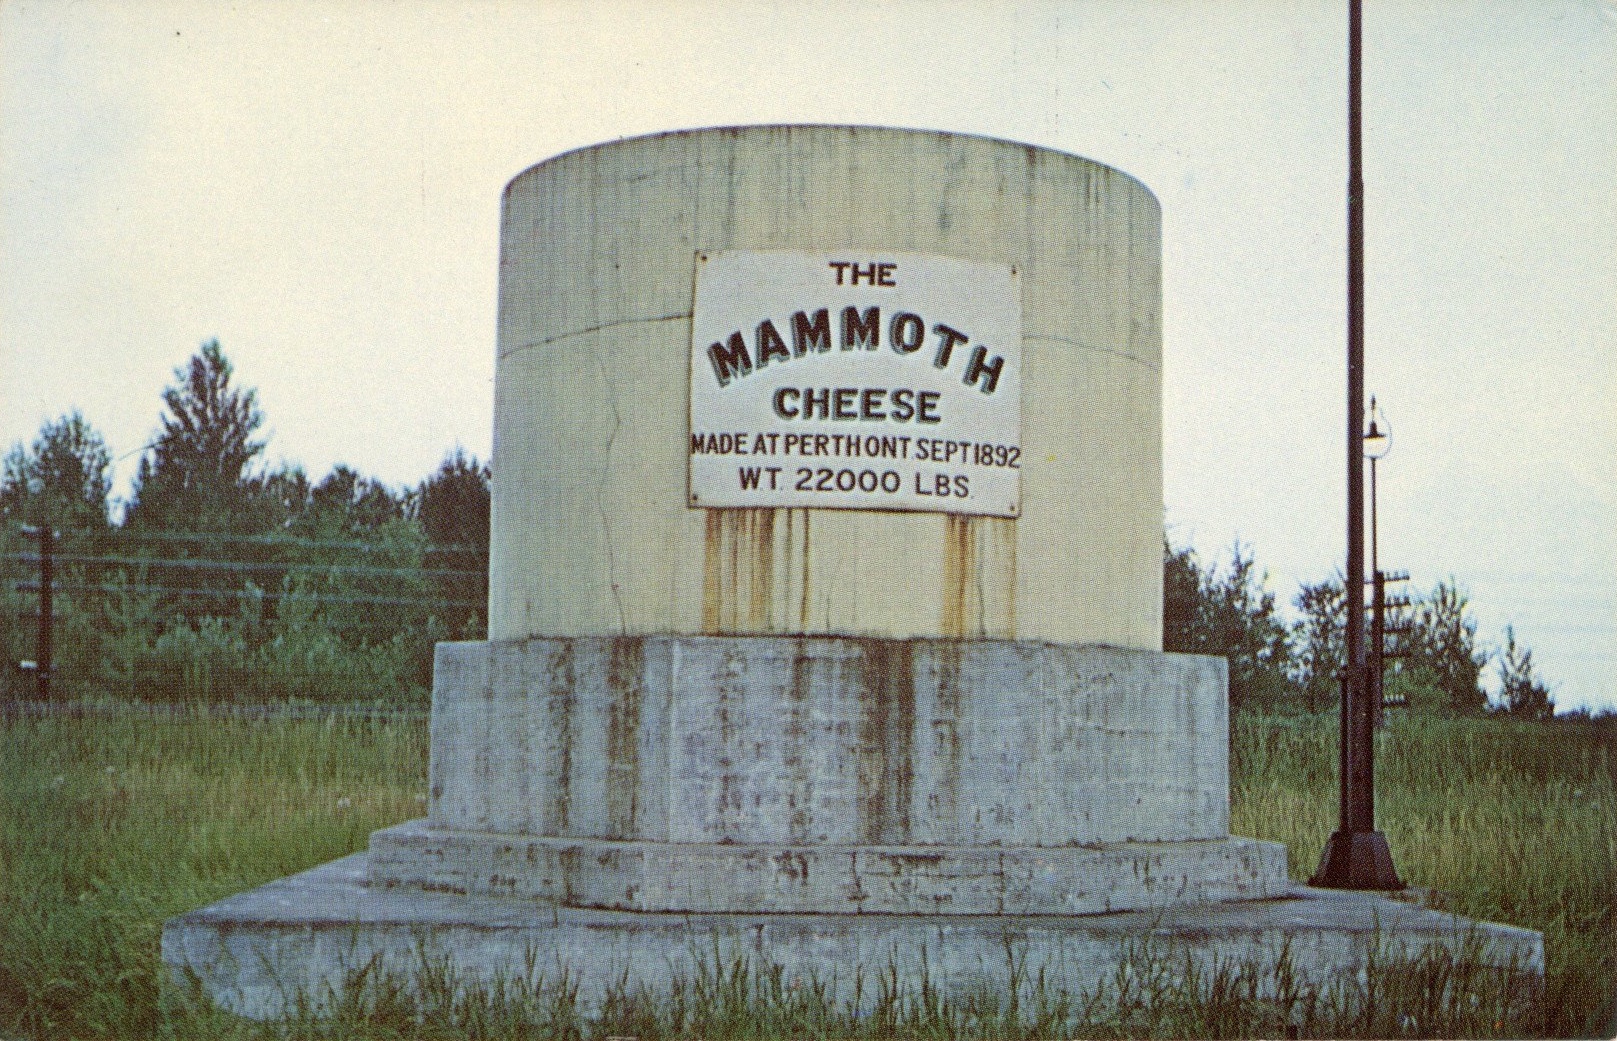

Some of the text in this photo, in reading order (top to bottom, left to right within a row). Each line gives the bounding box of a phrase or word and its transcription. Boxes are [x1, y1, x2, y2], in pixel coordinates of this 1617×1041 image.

[829, 261, 898, 286] THE
[707, 306, 1005, 394] MAMMOTH
[773, 387, 942, 423] CHEESE
[691, 433, 748, 455] MADE
[752, 434, 780, 455] AT
[784, 434, 860, 456] PERTH
[915, 438, 971, 464] SEPT
[973, 445, 1021, 469] 1892
[795, 468, 901, 494] 22000
